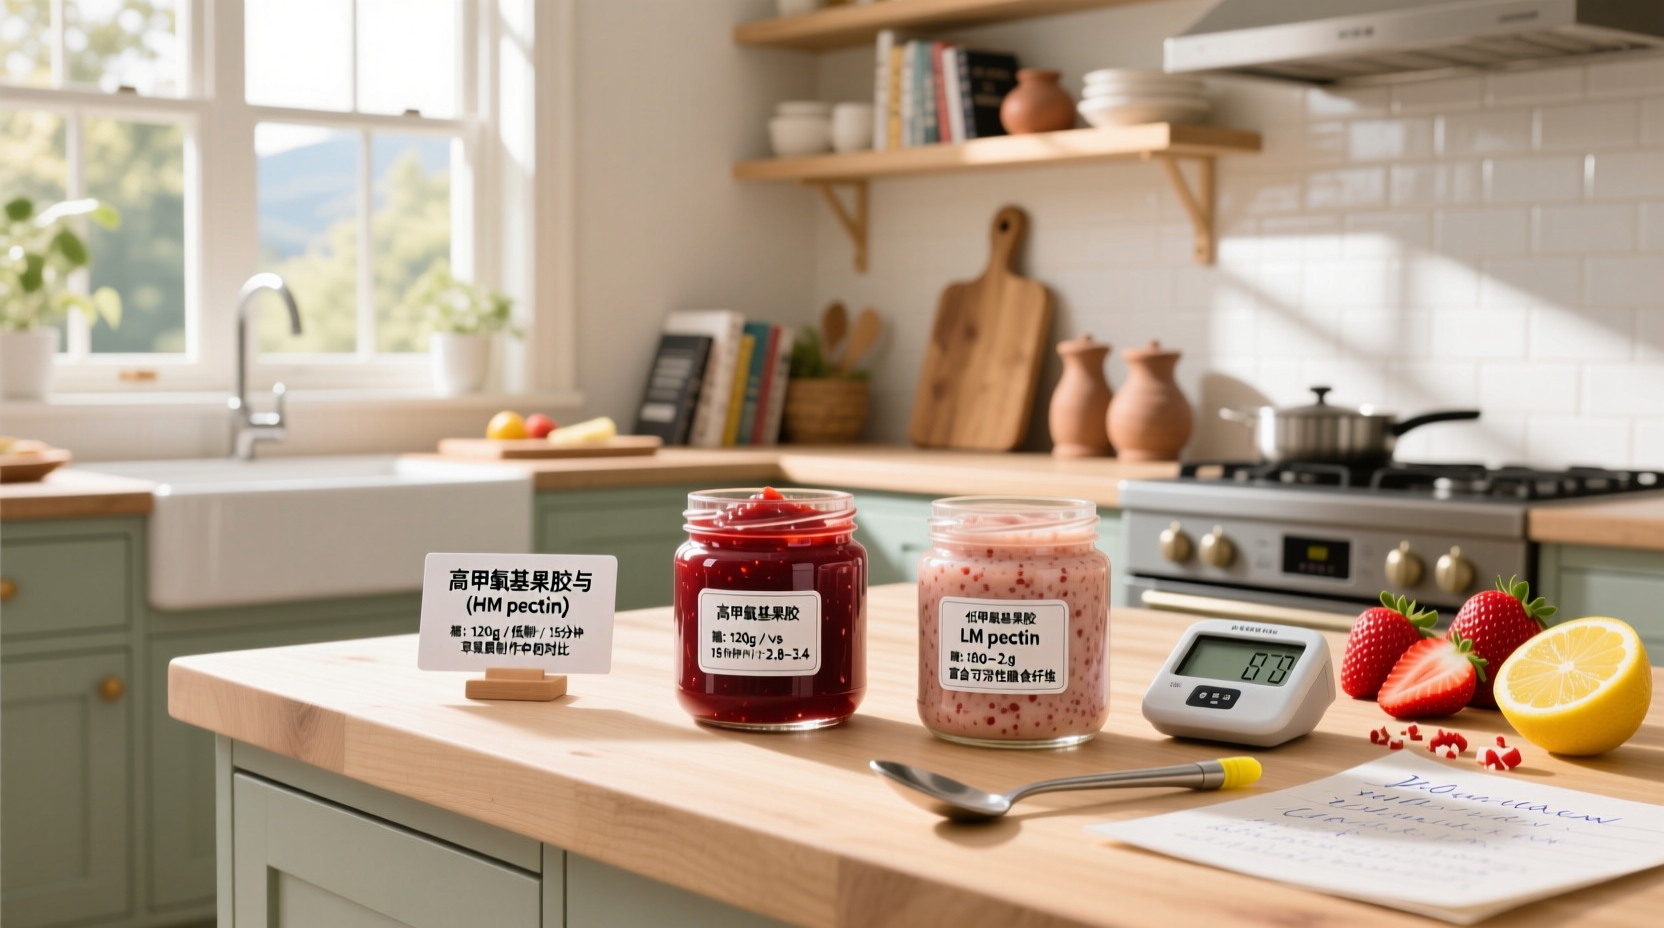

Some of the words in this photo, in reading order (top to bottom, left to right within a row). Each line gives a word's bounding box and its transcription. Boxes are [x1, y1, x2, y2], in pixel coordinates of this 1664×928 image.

[466, 595, 502, 616] (HM
[506, 595, 570, 618] pectin)
[471, 626, 500, 641] 120g
[729, 632, 757, 647] 120g
[960, 627, 984, 644] LM
[987, 629, 1040, 649] pectin
